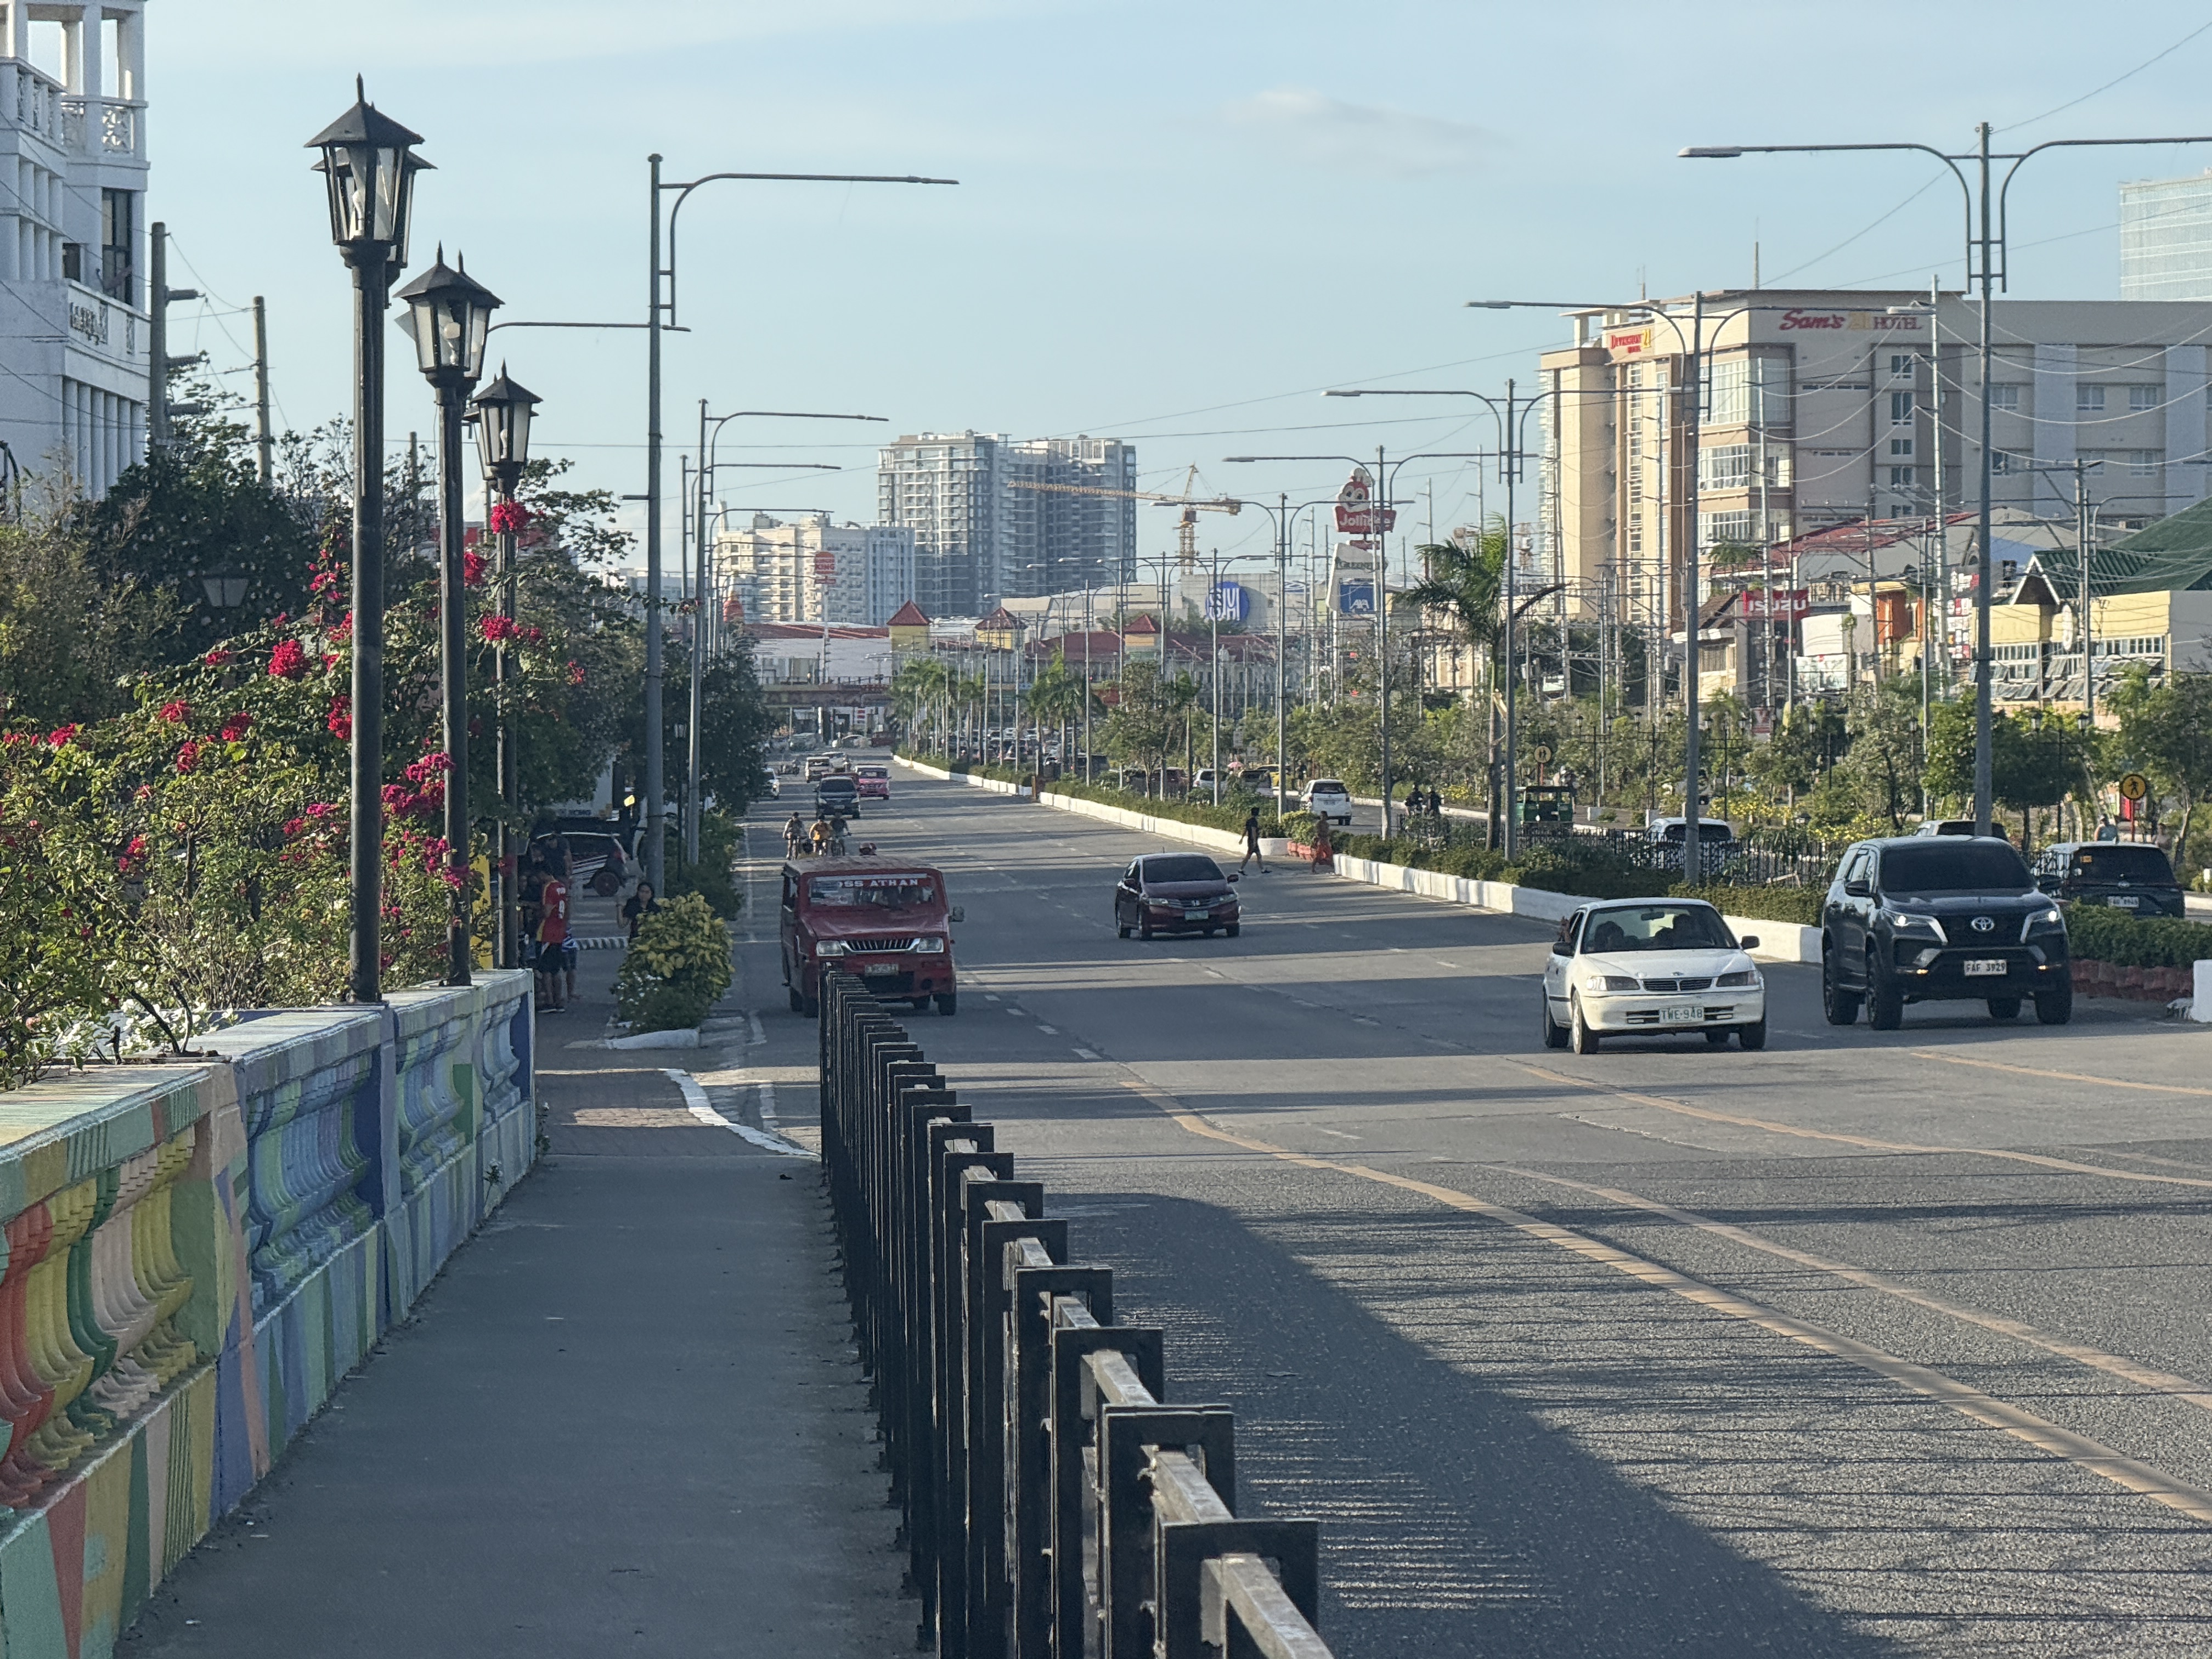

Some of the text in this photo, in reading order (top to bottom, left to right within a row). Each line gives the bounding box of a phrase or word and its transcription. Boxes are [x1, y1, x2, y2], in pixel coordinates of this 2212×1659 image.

[1779, 308, 1845, 330] Sam's
[1873, 316, 1923, 330] HOTEL
[1748, 599, 1806, 611] ISUZU
[871, 878, 918, 887] ATHAN
